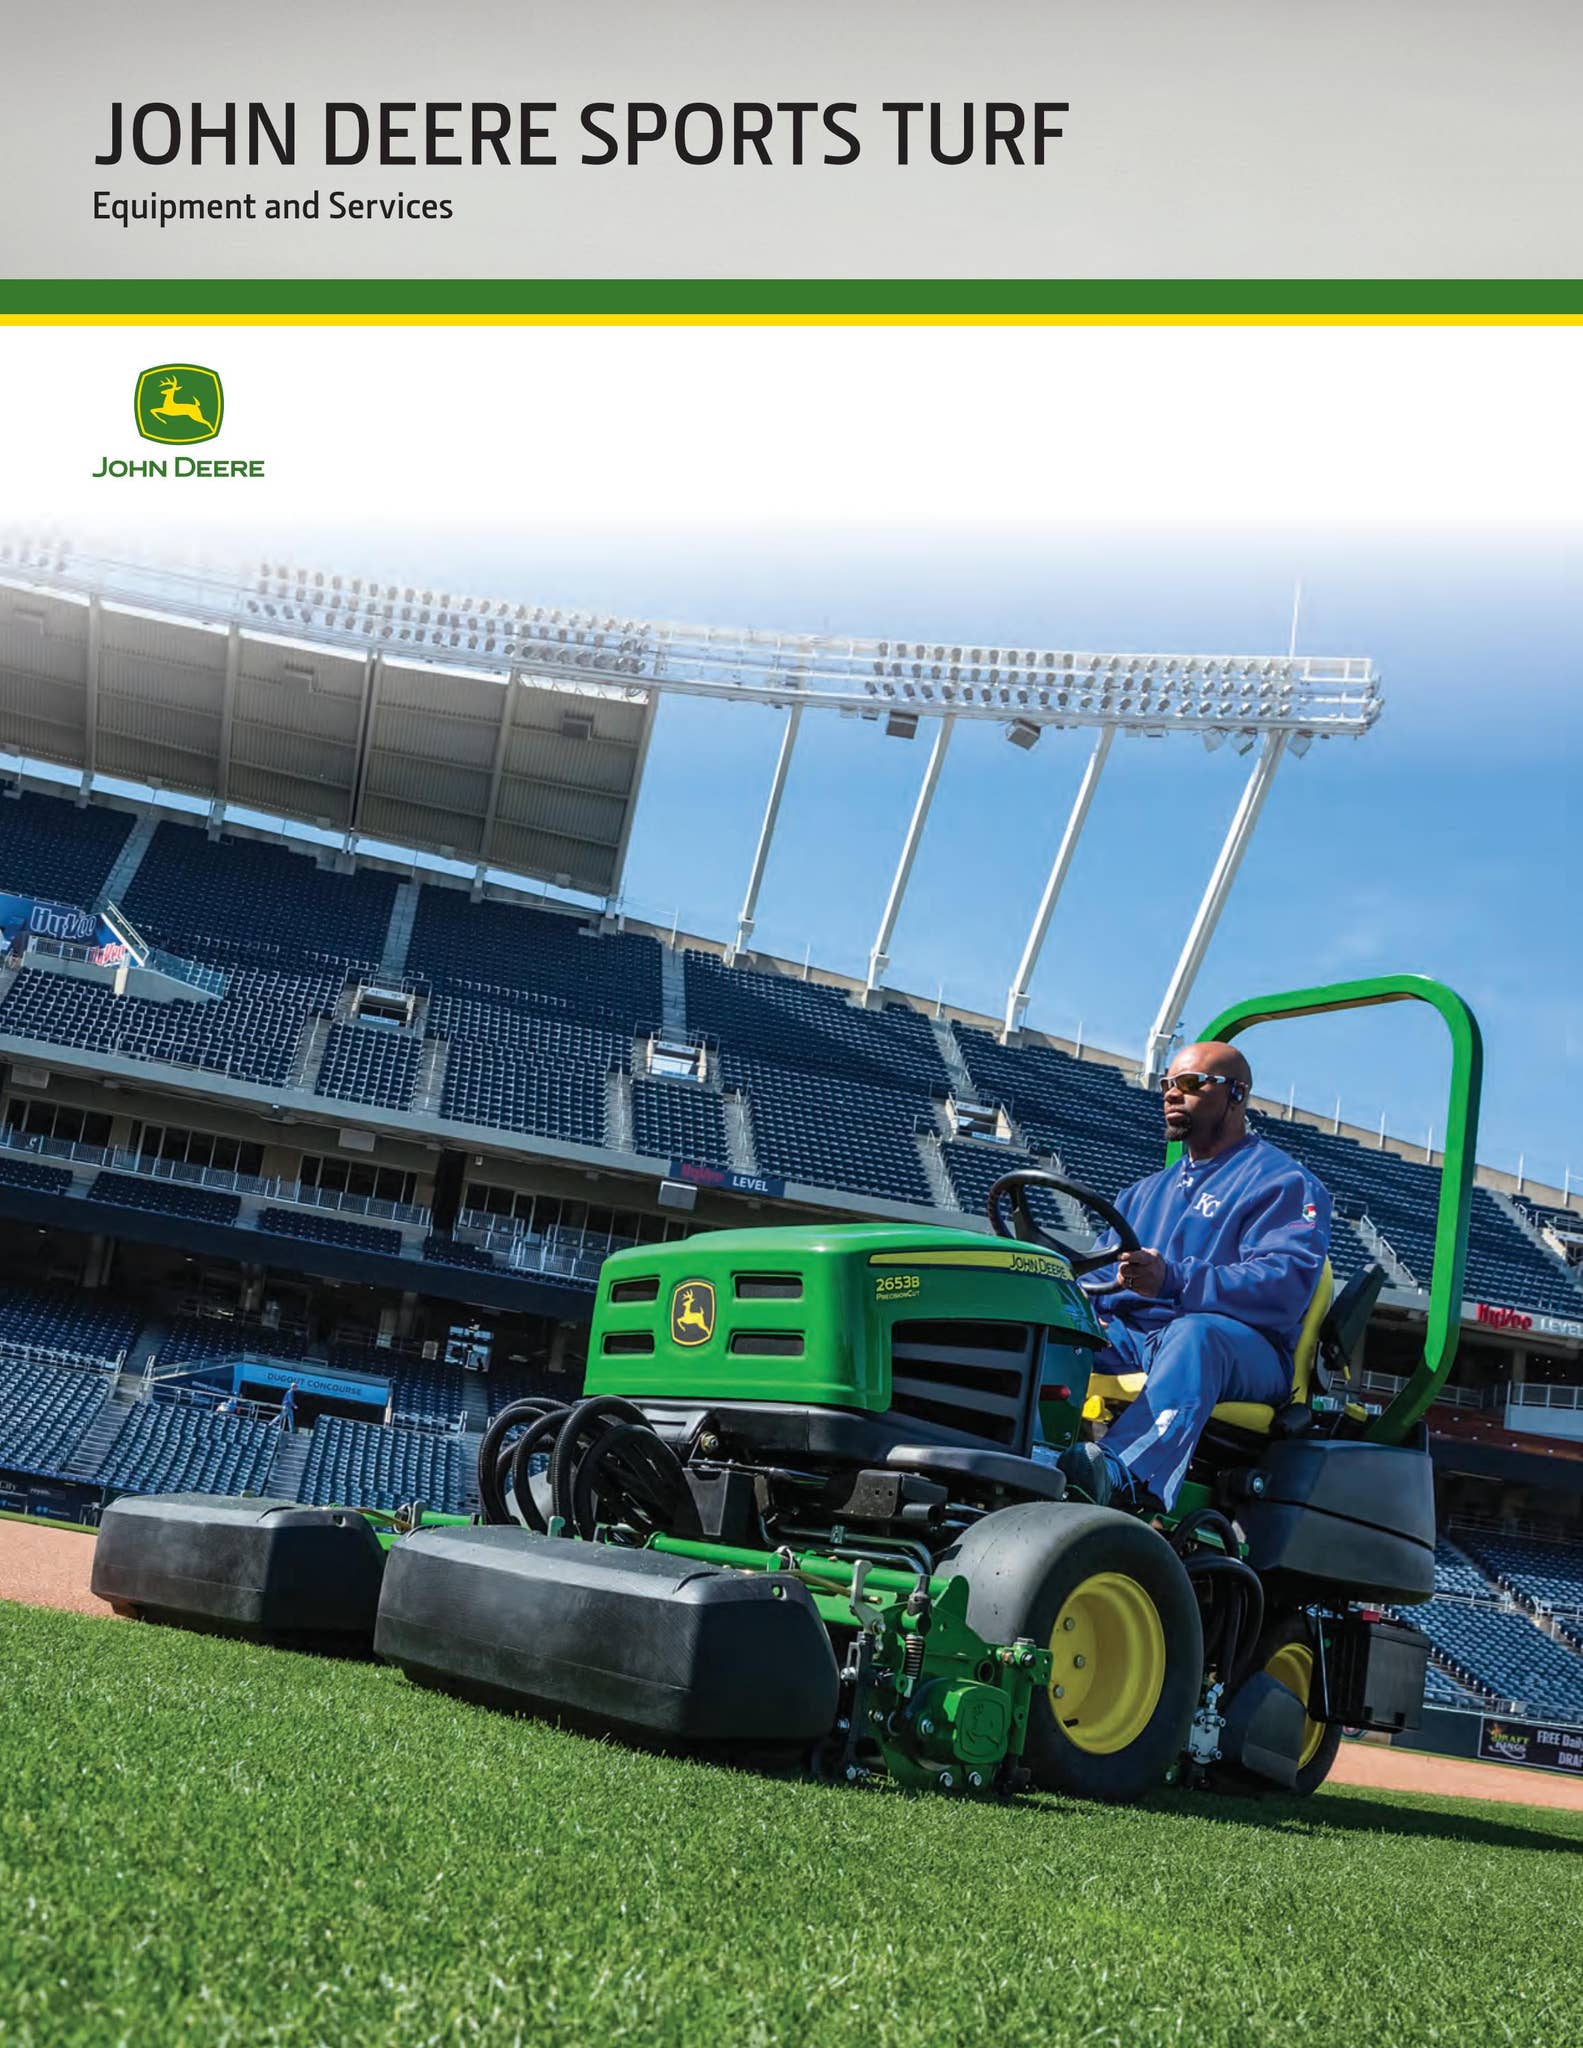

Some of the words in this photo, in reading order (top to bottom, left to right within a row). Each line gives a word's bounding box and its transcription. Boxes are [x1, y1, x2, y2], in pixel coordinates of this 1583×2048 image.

[732, 1175, 769, 1192] LEVEL
[1193, 1192, 1221, 1218] KC
[1010, 1253, 1038, 1273] JOHN
[1038, 1258, 1068, 1280] DEERE
[876, 1275, 920, 1292] 2653B
[307, 1379, 363, 1396] CONCOURSE
[1537, 1730, 1561, 1745] FREE
